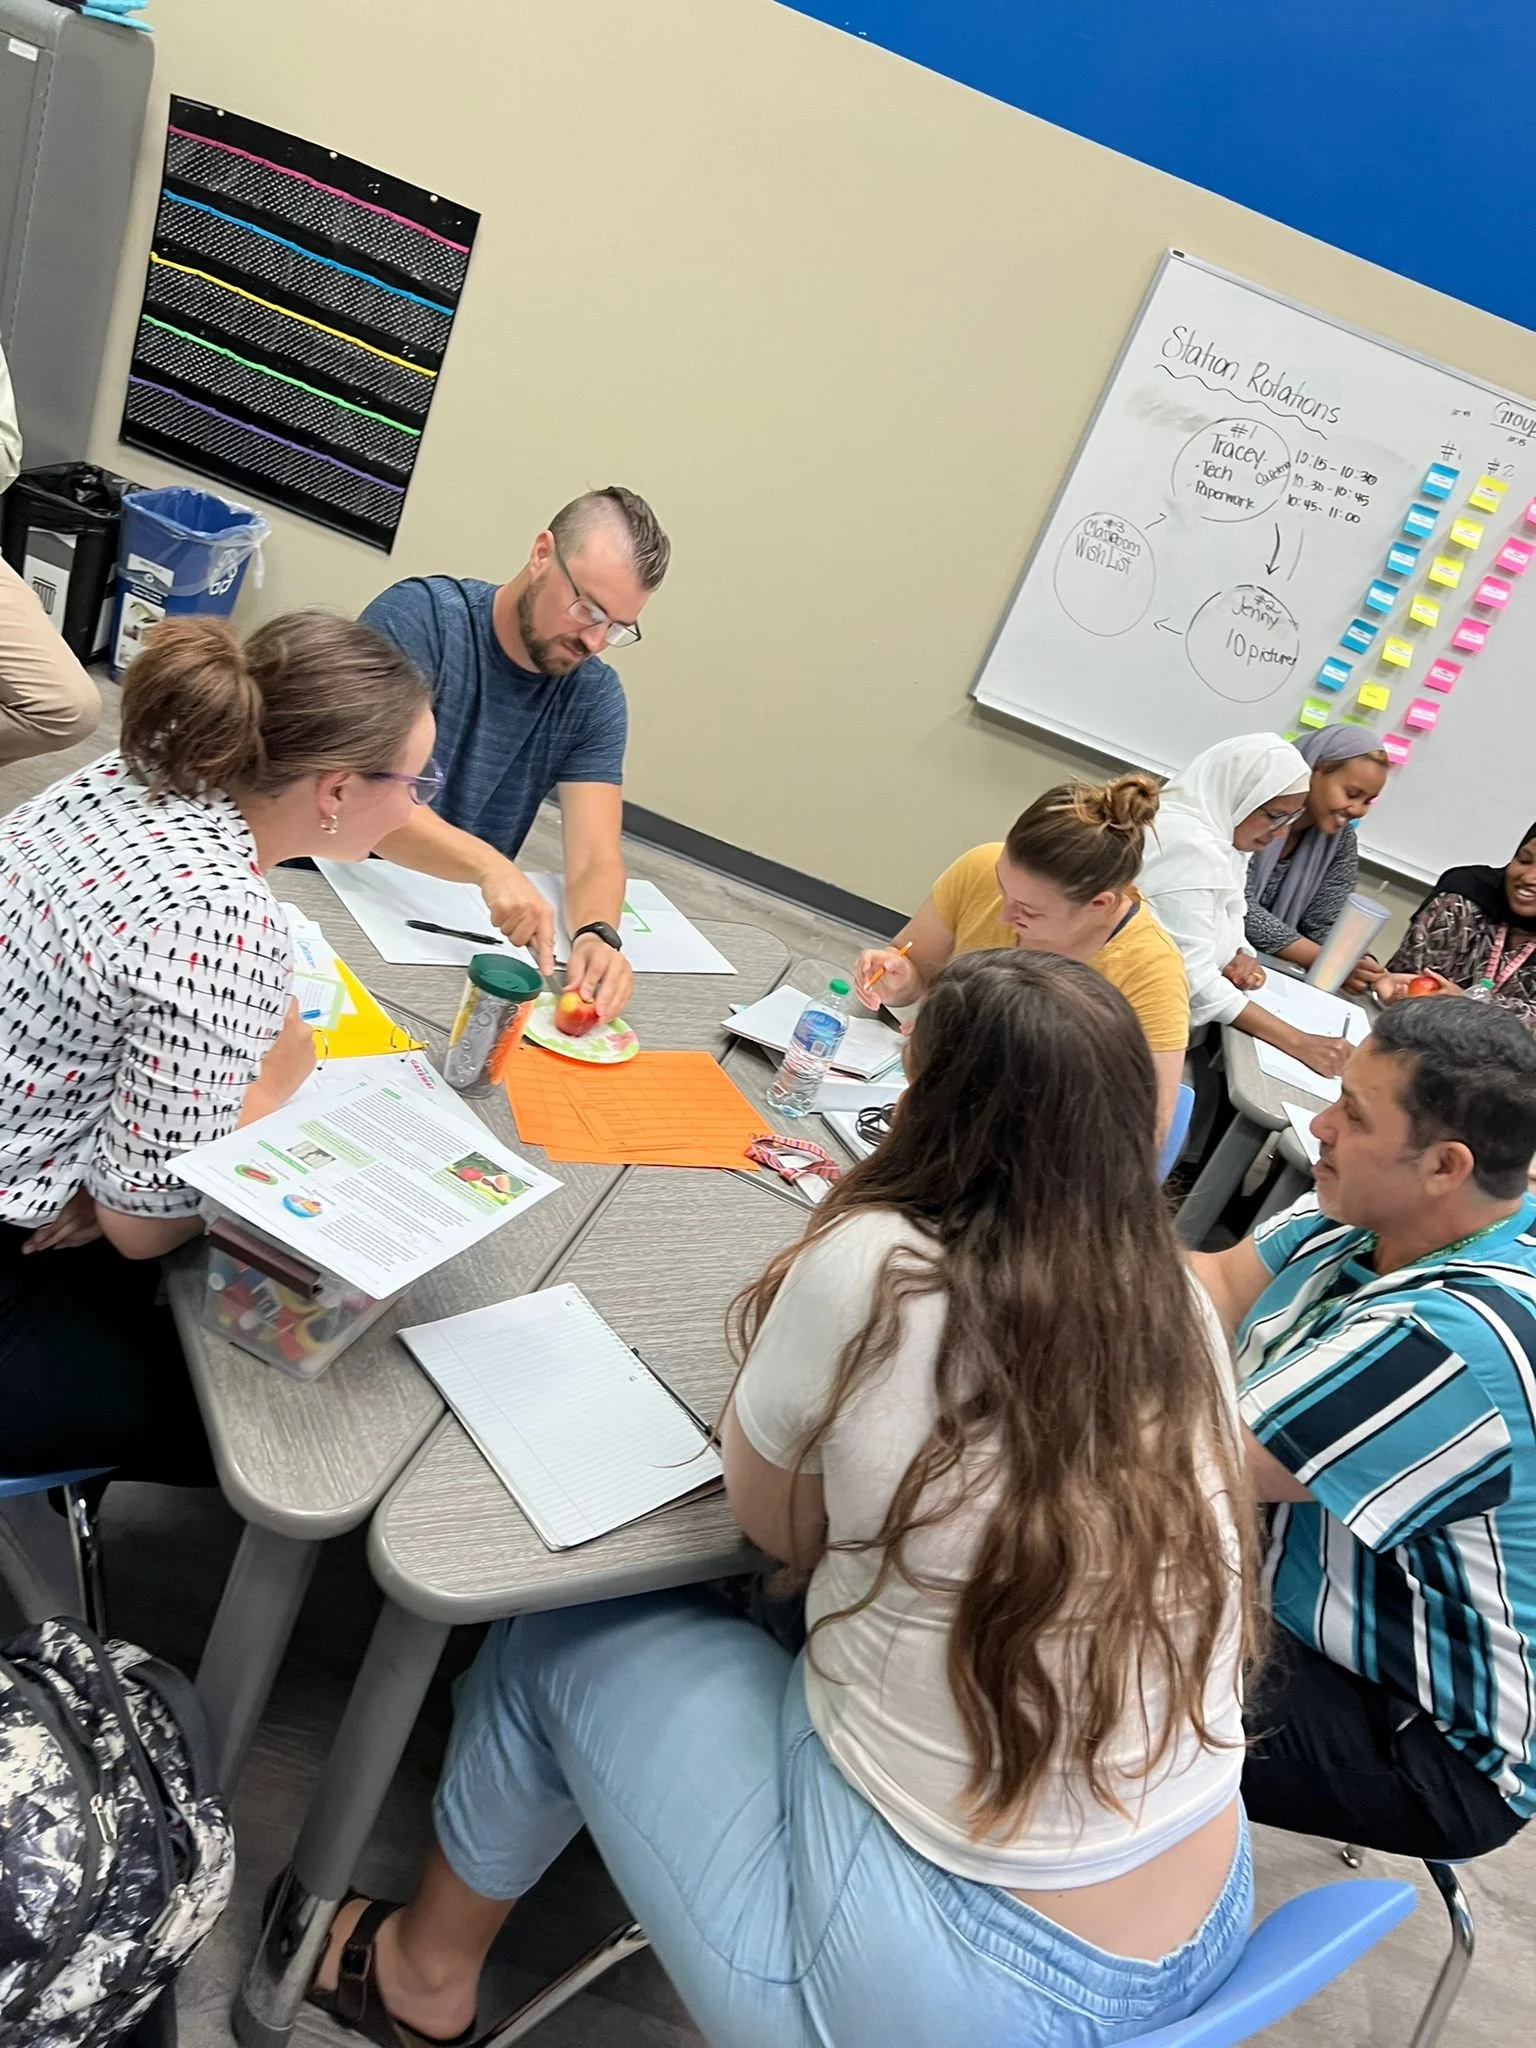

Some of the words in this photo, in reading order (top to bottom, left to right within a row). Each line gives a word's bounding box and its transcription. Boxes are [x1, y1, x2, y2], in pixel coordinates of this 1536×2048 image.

[1161, 325, 1240, 381] Station
[1246, 360, 1341, 424] Rotations
[1229, 423, 1258, 439] #1
[1211, 433, 1266, 470] Tracey
[1202, 460, 1233, 482] Tech
[1295, 449, 1328, 471] 10:15
[1340, 465, 1378, 486] 10:30
[1334, 485, 1370, 507] 10:45
[1328, 506, 1361, 524] 11:00
[1231, 595, 1280, 632] Jenny
[1225, 628, 1246, 657] 10
